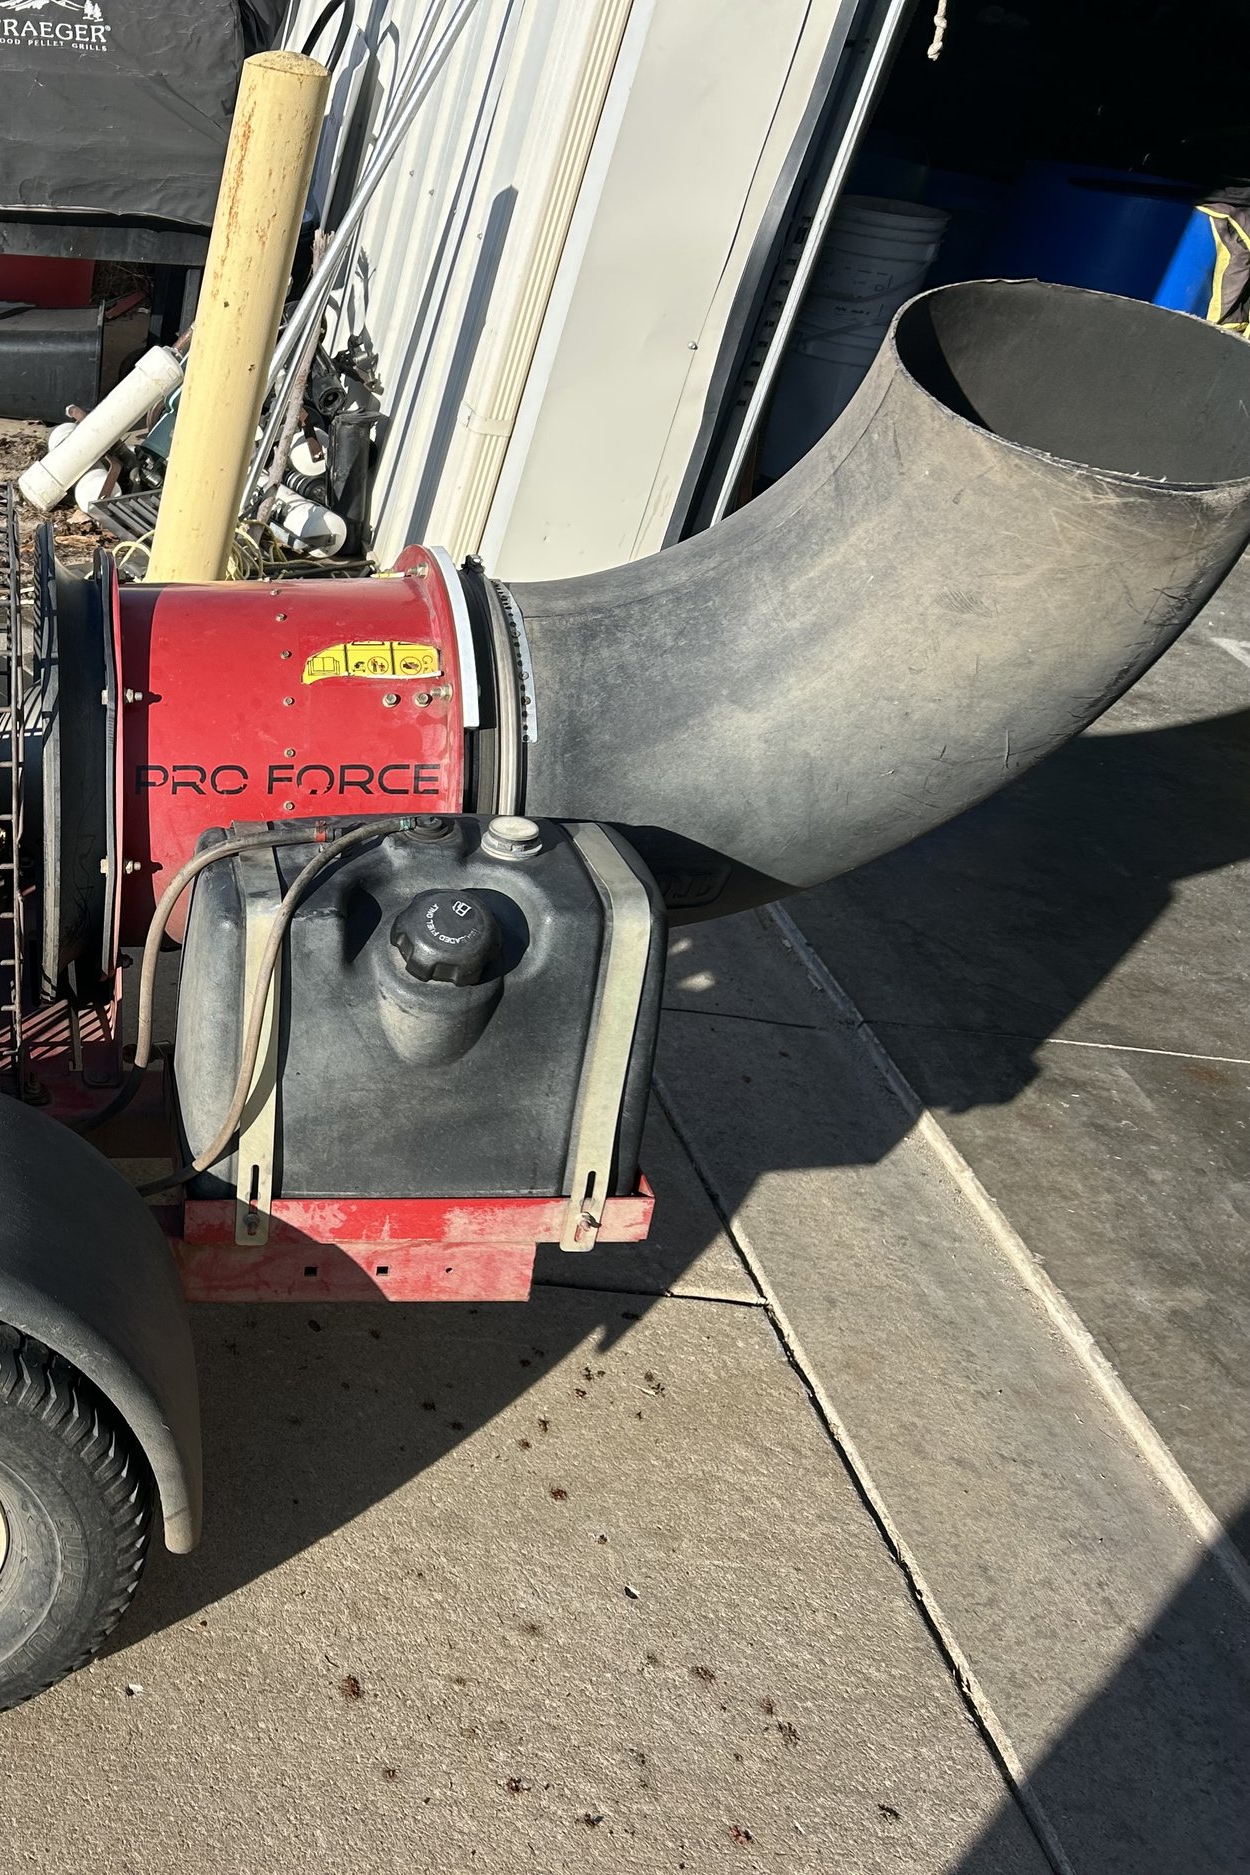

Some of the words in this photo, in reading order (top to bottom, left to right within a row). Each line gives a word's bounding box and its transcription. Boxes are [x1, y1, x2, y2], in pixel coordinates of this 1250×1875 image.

[27, 38, 65, 48] PELLET
[71, 42, 108, 52] GRILLS
[134, 764, 250, 796] PRO
[267, 764, 441, 796] FORCE
